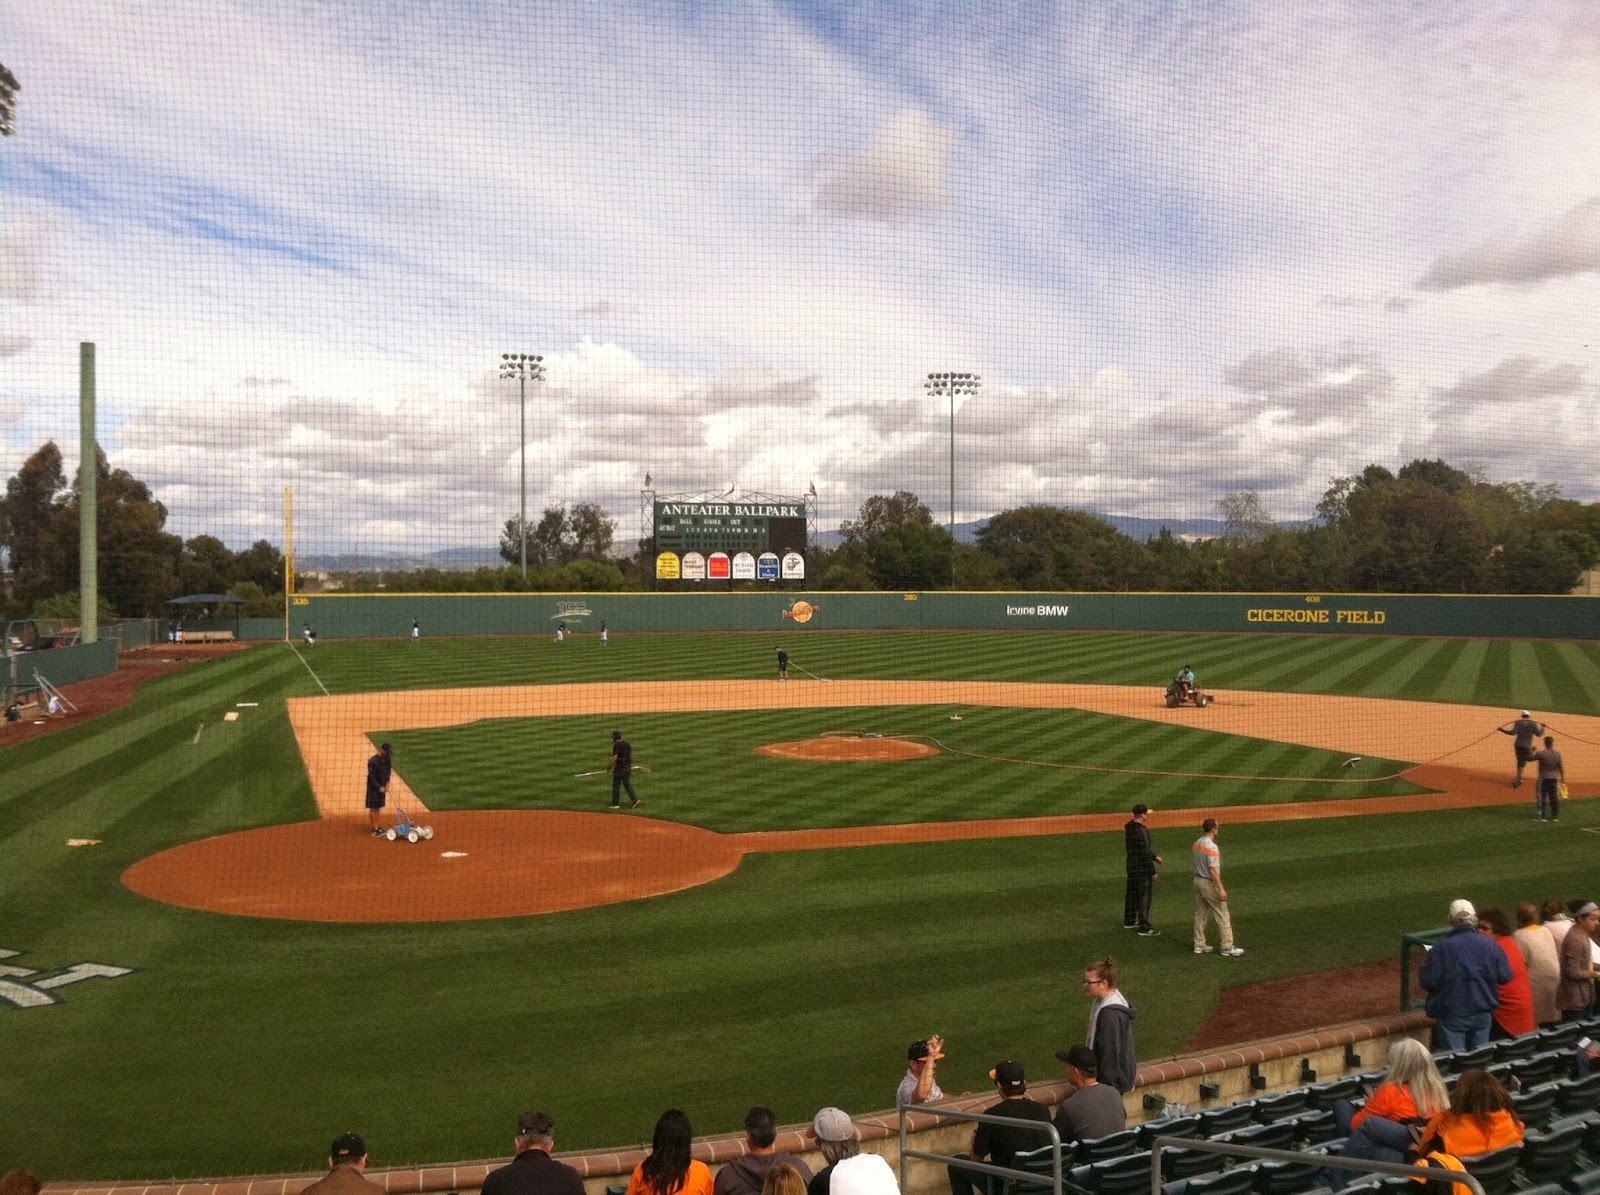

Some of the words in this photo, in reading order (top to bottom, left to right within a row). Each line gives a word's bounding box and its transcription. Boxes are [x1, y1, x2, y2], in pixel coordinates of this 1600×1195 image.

[662, 504, 731, 516] ANTEATER
[734, 505, 799, 517] BALLPARK
[556, 602, 586, 611] TCS
[1006, 605, 1036, 615] Irvine
[1037, 605, 1069, 616] BMW
[1247, 609, 1329, 623] CICERONE
[1336, 610, 1386, 624] FIELD
